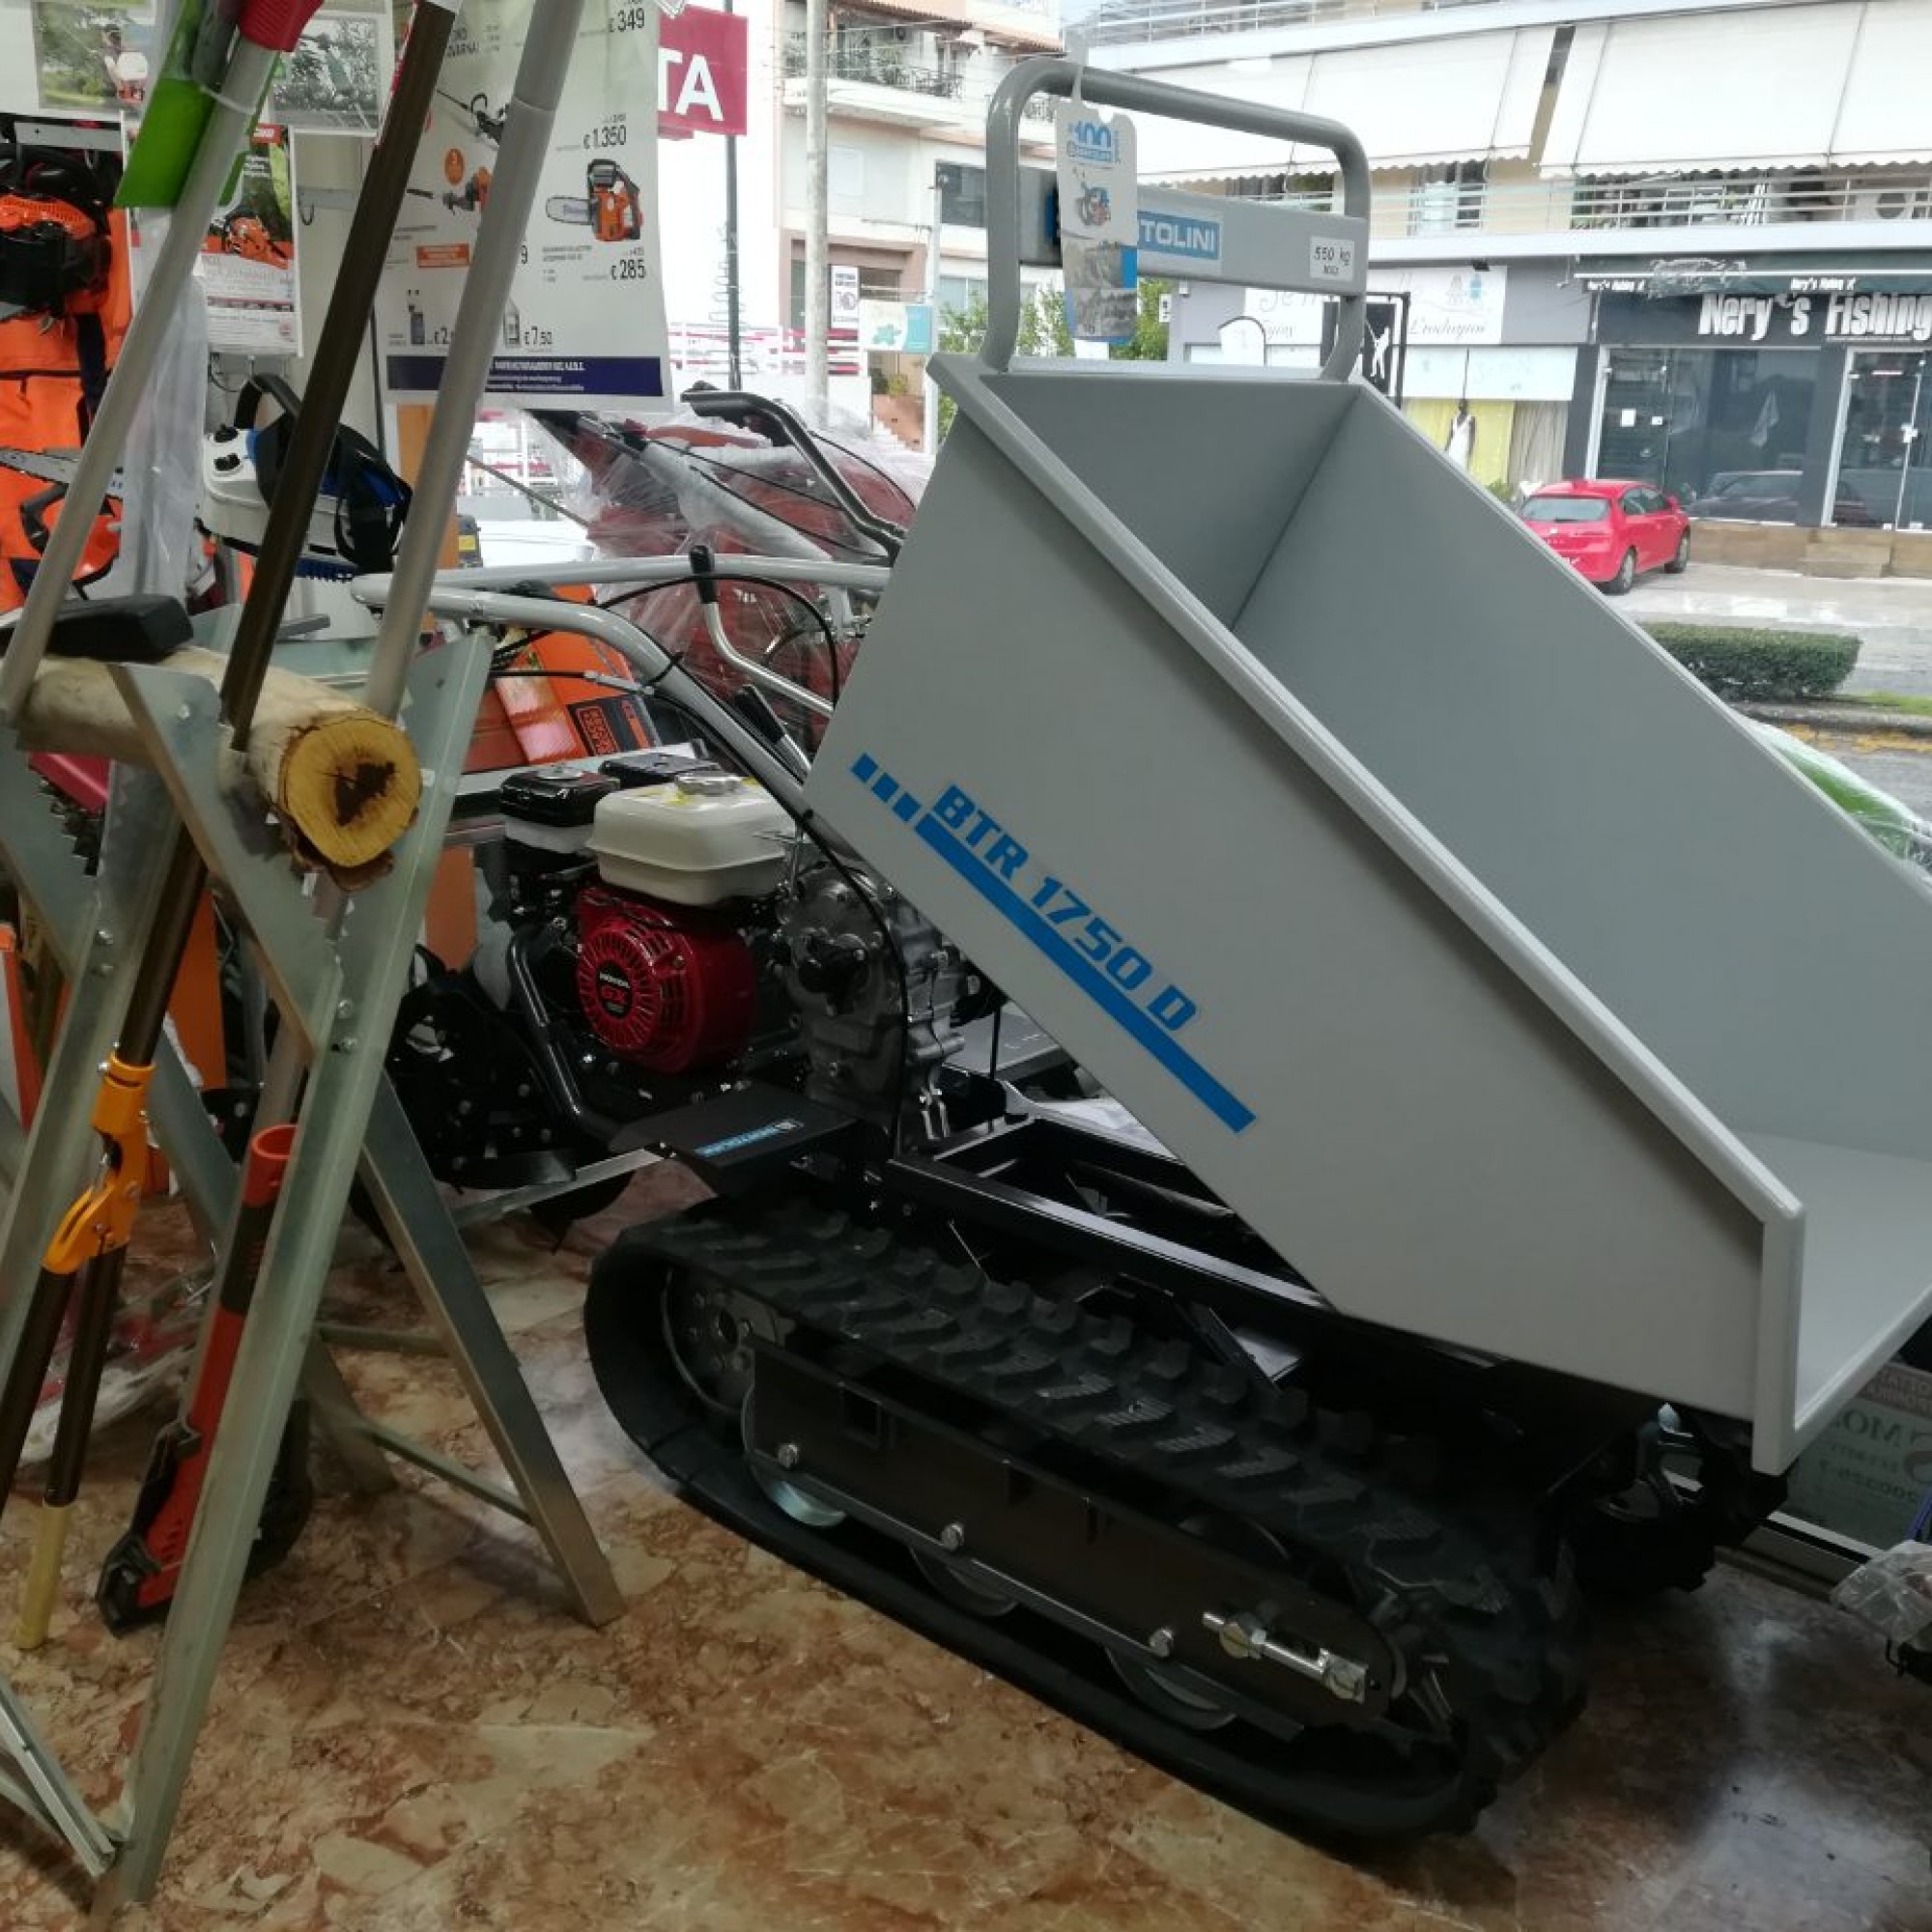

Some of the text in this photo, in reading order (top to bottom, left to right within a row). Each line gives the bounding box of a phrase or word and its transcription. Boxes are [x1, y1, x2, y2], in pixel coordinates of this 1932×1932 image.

[657, 47, 724, 122] TA
[1697, 293, 1932, 341] Nery's Fishing
[932, 783, 1198, 1032] BTR 1750 D
